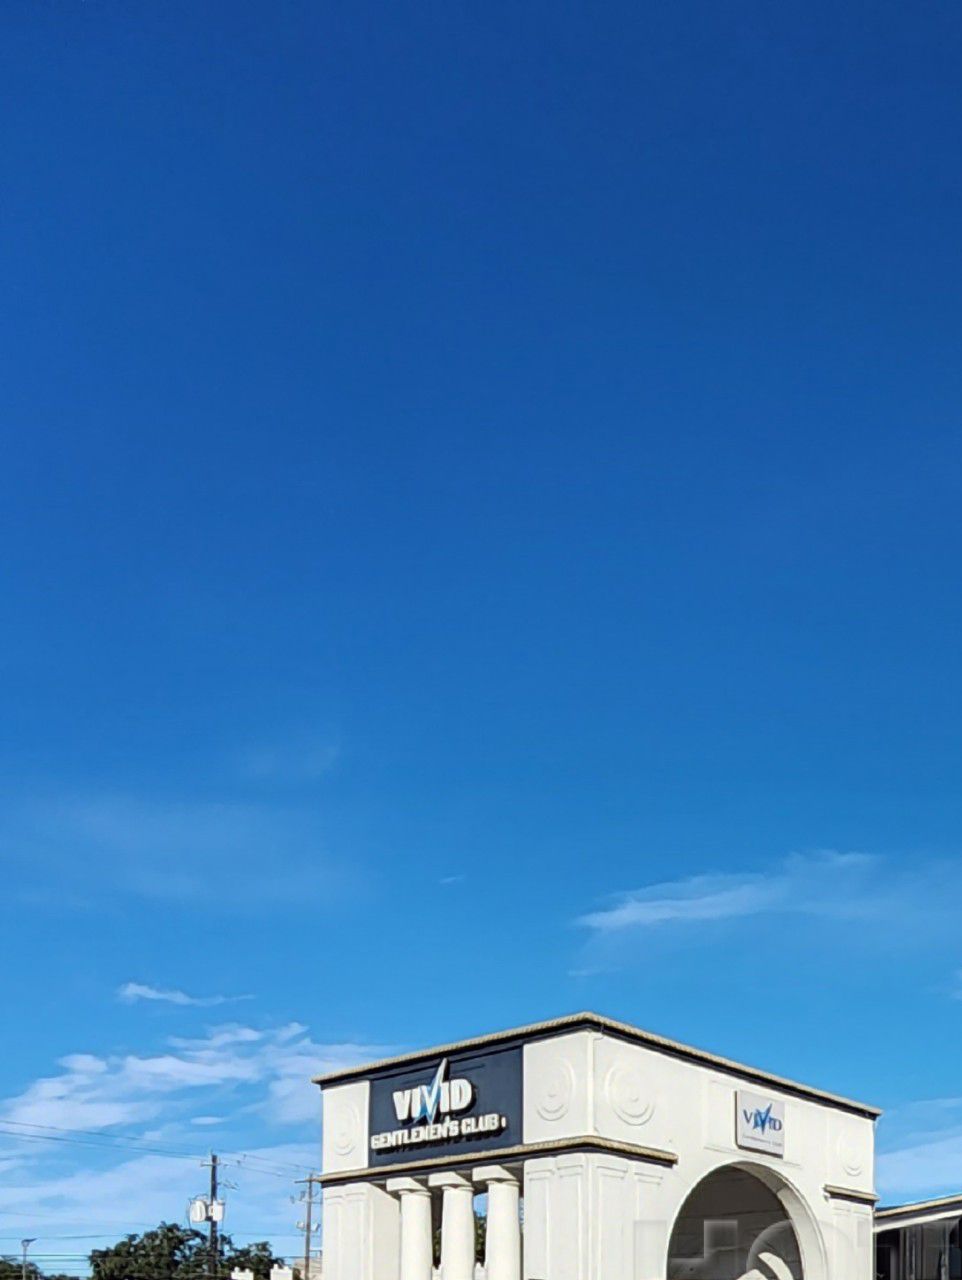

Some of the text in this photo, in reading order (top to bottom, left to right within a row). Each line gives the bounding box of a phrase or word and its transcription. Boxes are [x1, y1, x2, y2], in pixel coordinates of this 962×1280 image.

[392, 1058, 472, 1126] VIVID
[371, 1113, 500, 1149] GENTLEMEN'S CLUB
